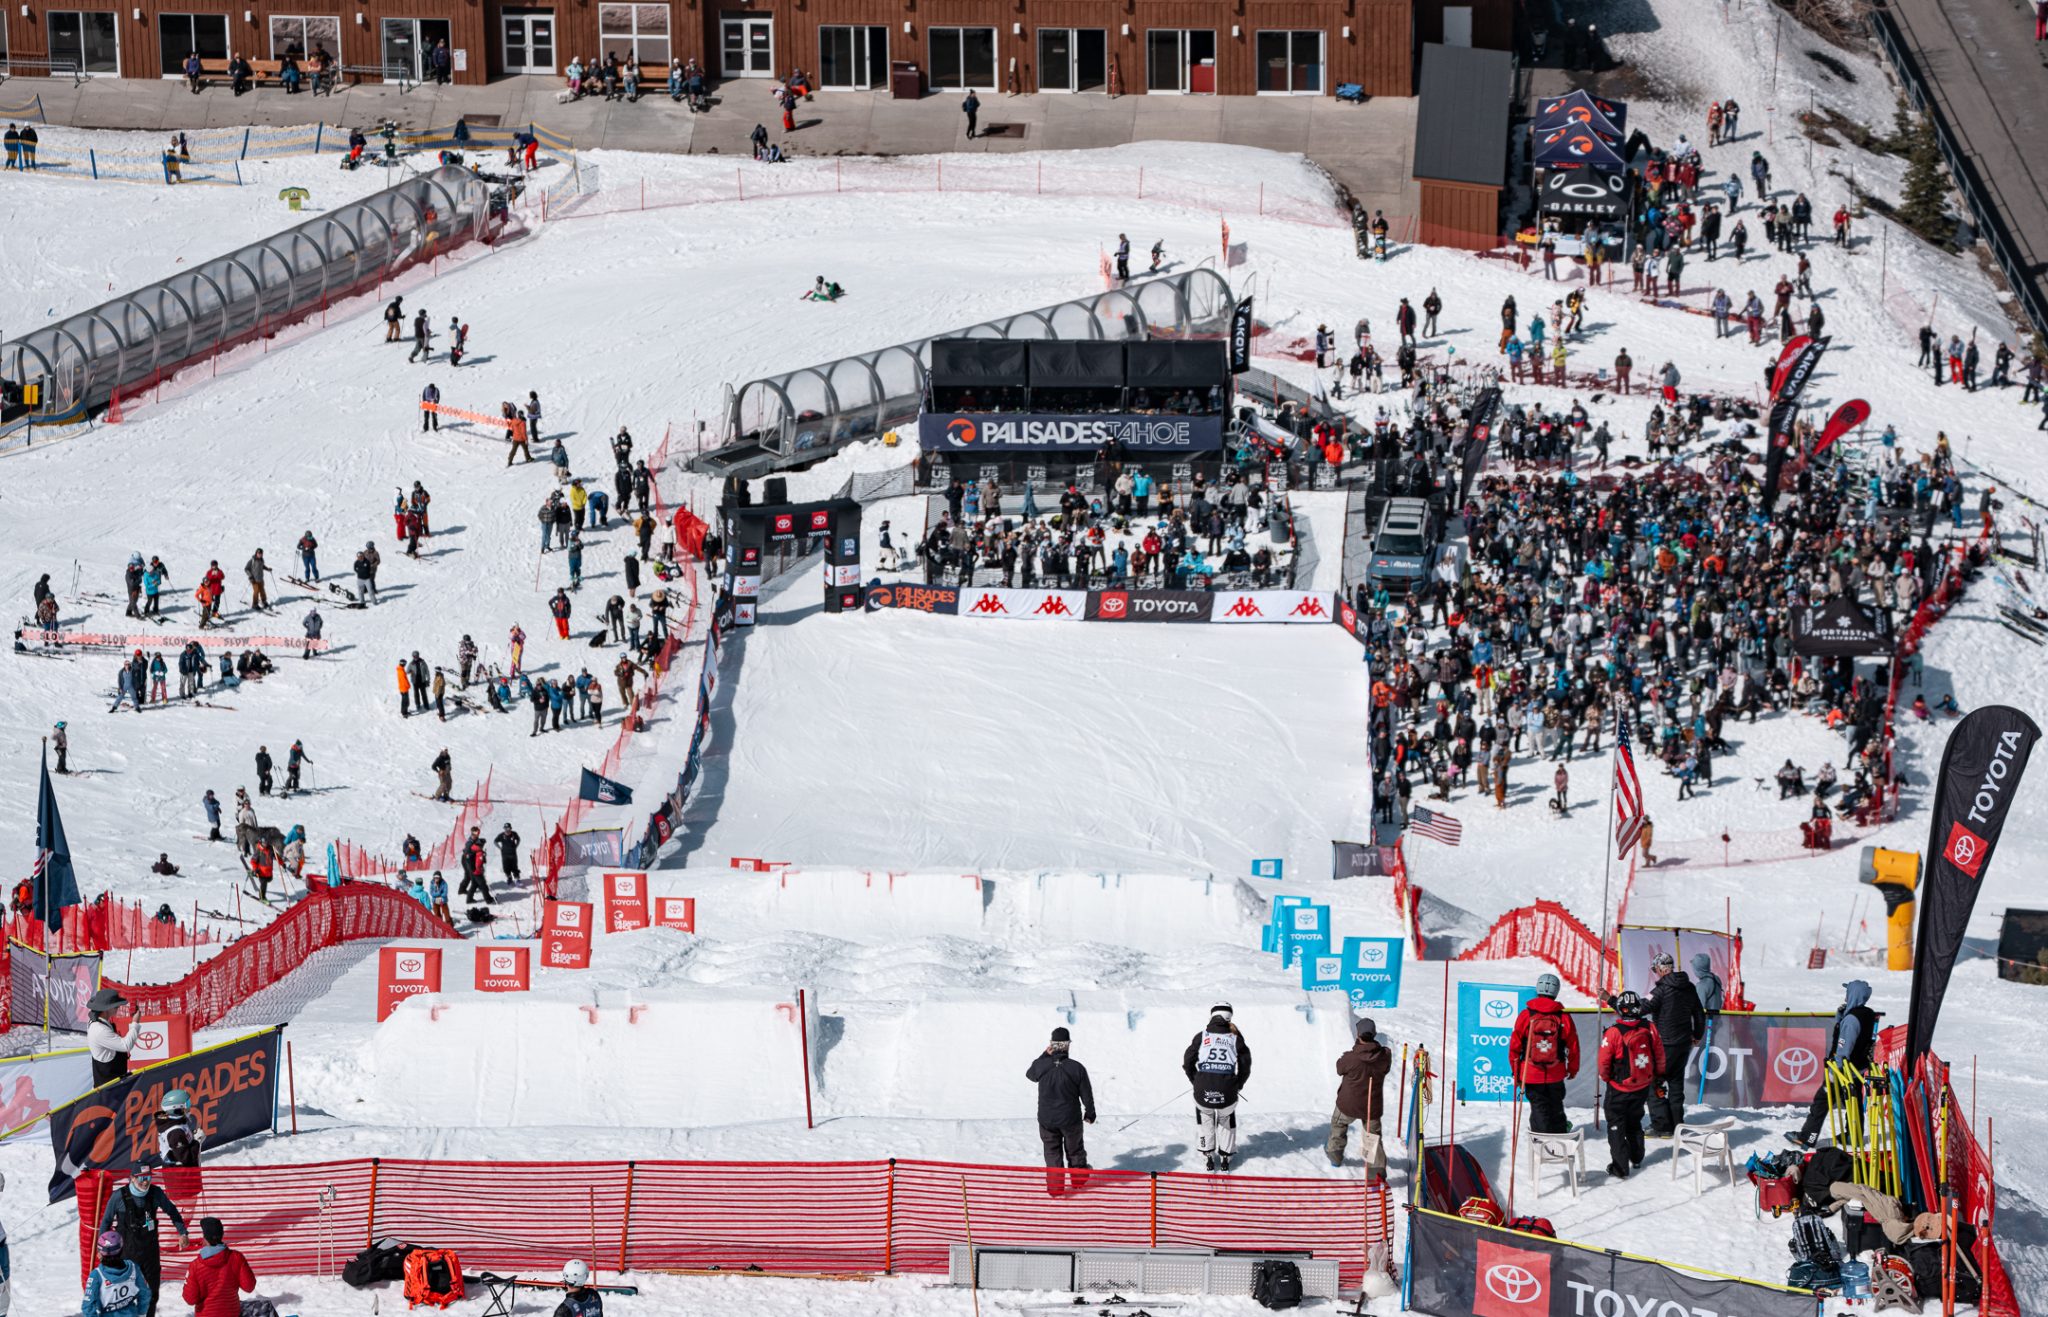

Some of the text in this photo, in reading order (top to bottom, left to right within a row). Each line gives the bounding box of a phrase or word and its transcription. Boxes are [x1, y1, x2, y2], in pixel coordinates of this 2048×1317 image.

[1550, 202, 1617, 214] OAKLEY
[1235, 316, 1246, 366] AKOVA
[1786, 351, 1815, 396] AKOVA
[982, 421, 1190, 444] PALISADES TAHOE
[1173, 468, 1192, 476] US
[772, 533, 795, 541] TOYOTA
[808, 530, 832, 538] TOYOTA
[895, 587, 955, 603] PALISADES
[897, 597, 934, 612] TAHOE
[1133, 599, 1199, 613] TOYOTA
[39, 632, 66, 641] SLOW
[101, 635, 127, 644] SLOW
[162, 637, 189, 645] SLOW
[223, 637, 250, 645] SLOW
[1812, 628, 1875, 639] NORTHSTAR
[1968, 730, 2023, 824] TOYOTA
[550, 929, 584, 938] TOYOTA
[1290, 933, 1323, 941] TOYOTA
[484, 979, 521, 988] TOYOTA
[1351, 972, 1391, 982] TOYOTA
[389, 985, 430, 994] TOYOTA
[1310, 984, 1340, 992] TOYOT
[1470, 1033, 1511, 1046] TOYO
[1208, 1048, 1228, 1061] 53
[1473, 1074, 1514, 1087] PALISAD
[124, 1050, 267, 1131] PALSADES
[1475, 1083, 1508, 1094] TAHOE
[125, 1099, 220, 1163] TAOE
[1808, 1132, 1818, 1143] USA
[113, 1285, 129, 1301] 10
